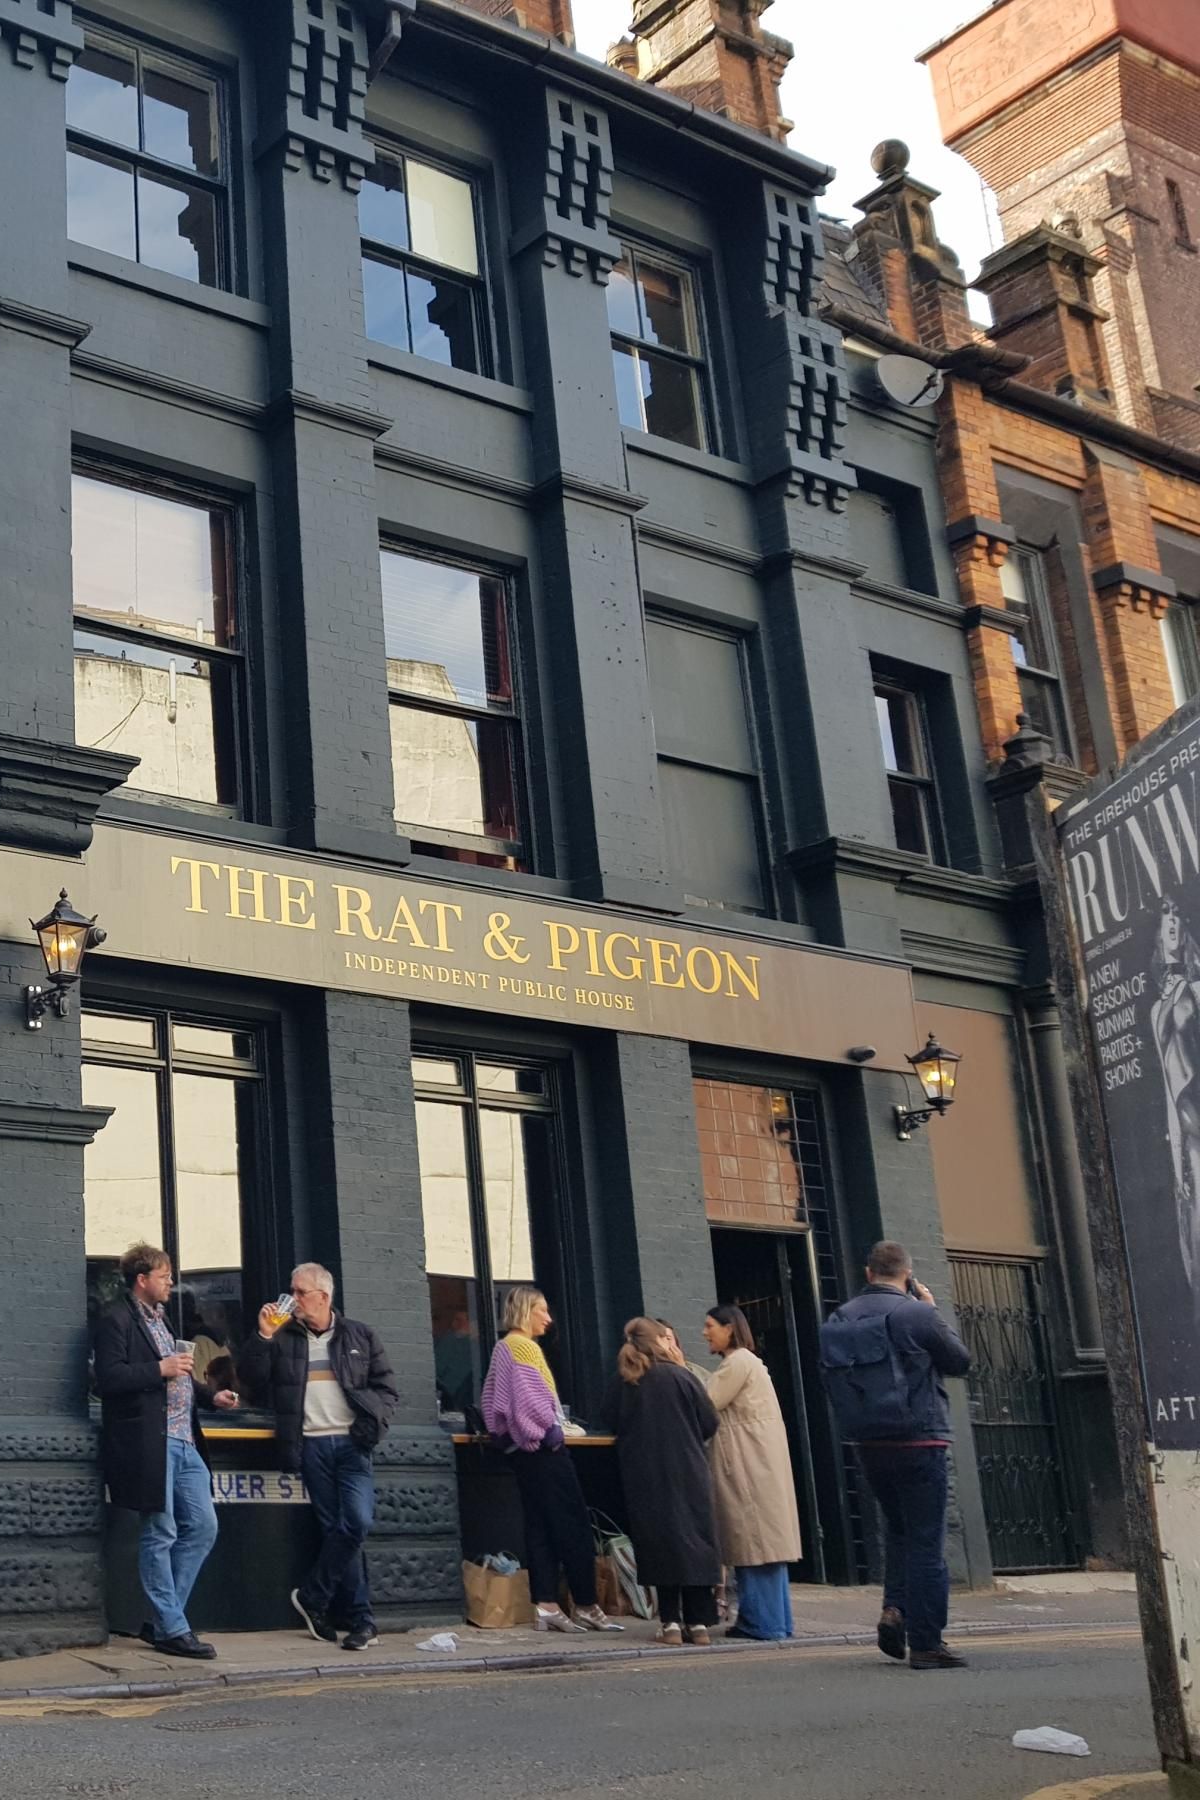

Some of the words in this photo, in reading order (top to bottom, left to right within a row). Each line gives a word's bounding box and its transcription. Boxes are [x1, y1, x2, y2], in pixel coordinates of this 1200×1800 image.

[1067, 821, 1093, 848] THE
[1094, 764, 1168, 831] FIREHOUSE
[1169, 737, 1200, 776] PRE
[171, 856, 316, 930] THE
[331, 884, 463, 953] RAT
[483, 912, 531, 965] &
[542, 920, 762, 1002] PIGEON
[344, 951, 490, 991] INDEPENDENT
[498, 978, 568, 1004] PUBLIC
[575, 989, 636, 1013] HOUSE
[1096, 958, 1120, 988] NEW
[1092, 979, 1133, 1018] SEASON
[1131, 971, 1147, 996] OF
[1096, 1004, 1136, 1041] RUNWAY
[1101, 1033, 1135, 1066] PARTIES
[215, 1473, 266, 1499] VER
